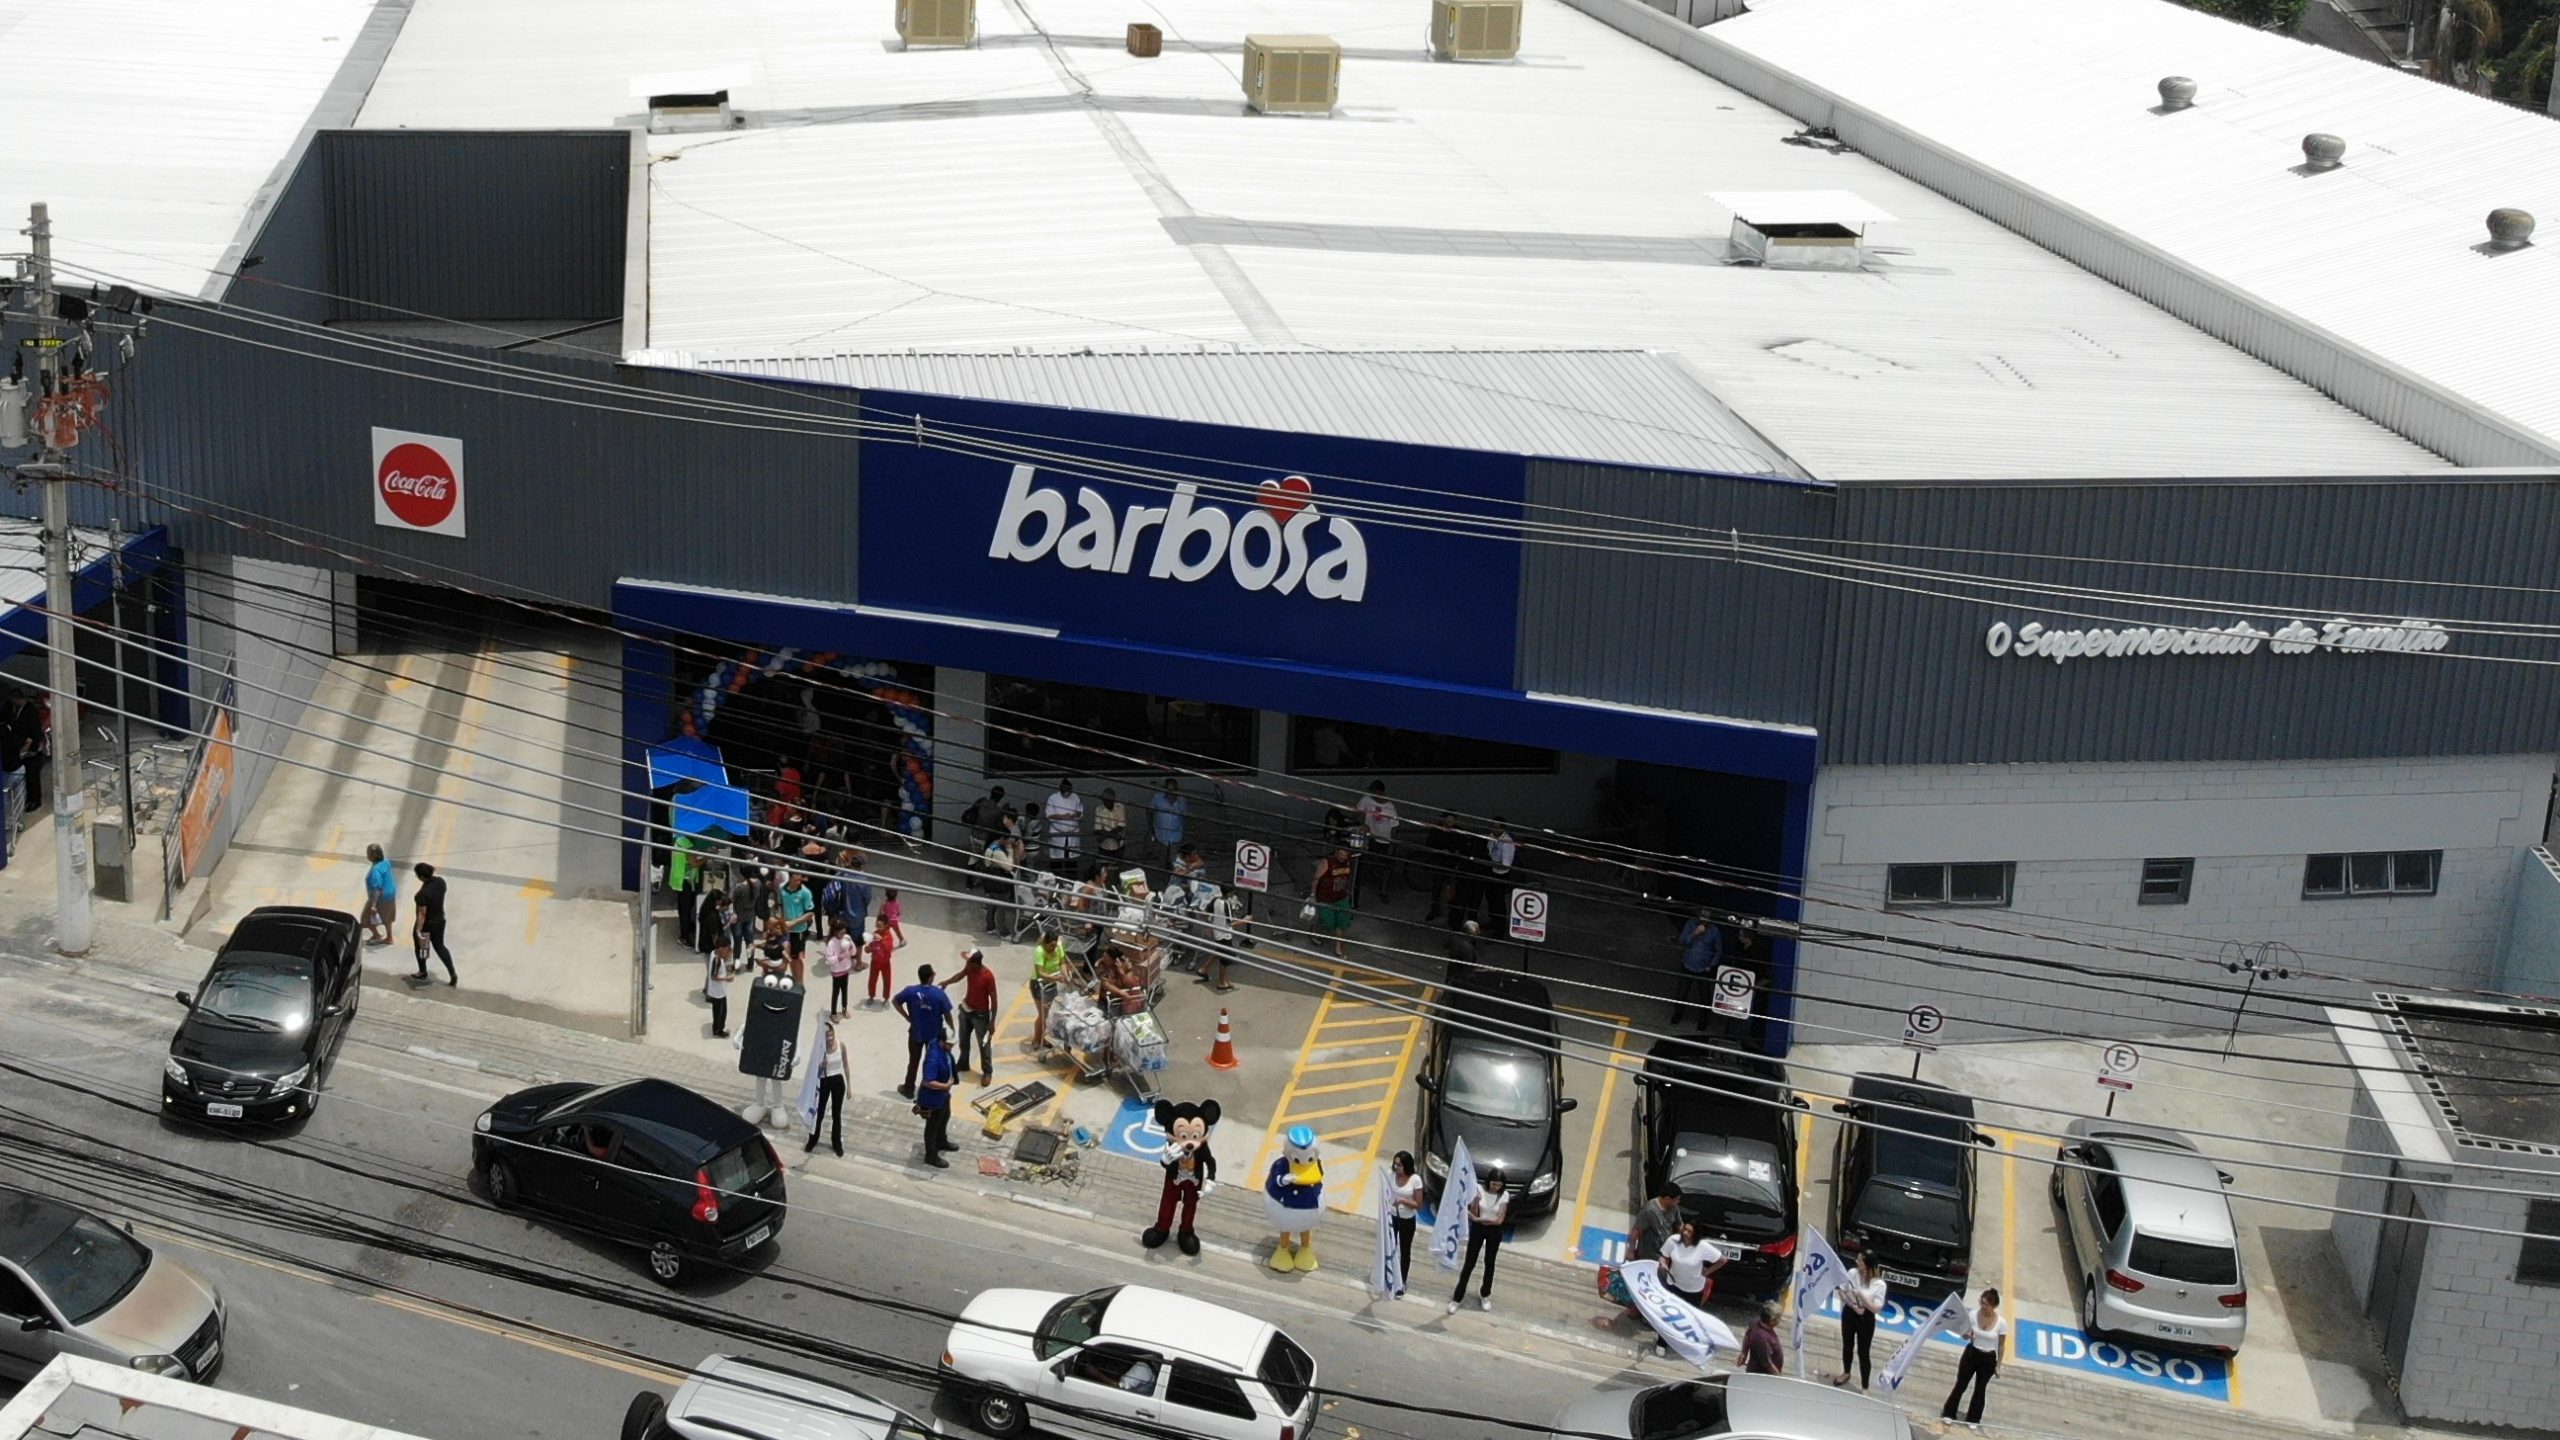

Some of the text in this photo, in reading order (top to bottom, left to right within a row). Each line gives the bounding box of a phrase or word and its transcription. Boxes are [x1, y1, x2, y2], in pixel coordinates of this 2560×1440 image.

[988, 464, 1368, 602] barbosa
[1986, 621, 2012, 657] O
[2014, 620, 2270, 664] Supermercado
[1247, 848, 1258, 867] E
[1523, 897, 1536, 915] E
[1728, 974, 1742, 992] E
[1918, 1010, 1933, 1028] E
[2113, 1049, 2129, 1067] E
[2036, 1329, 2203, 1385] IDOSO
